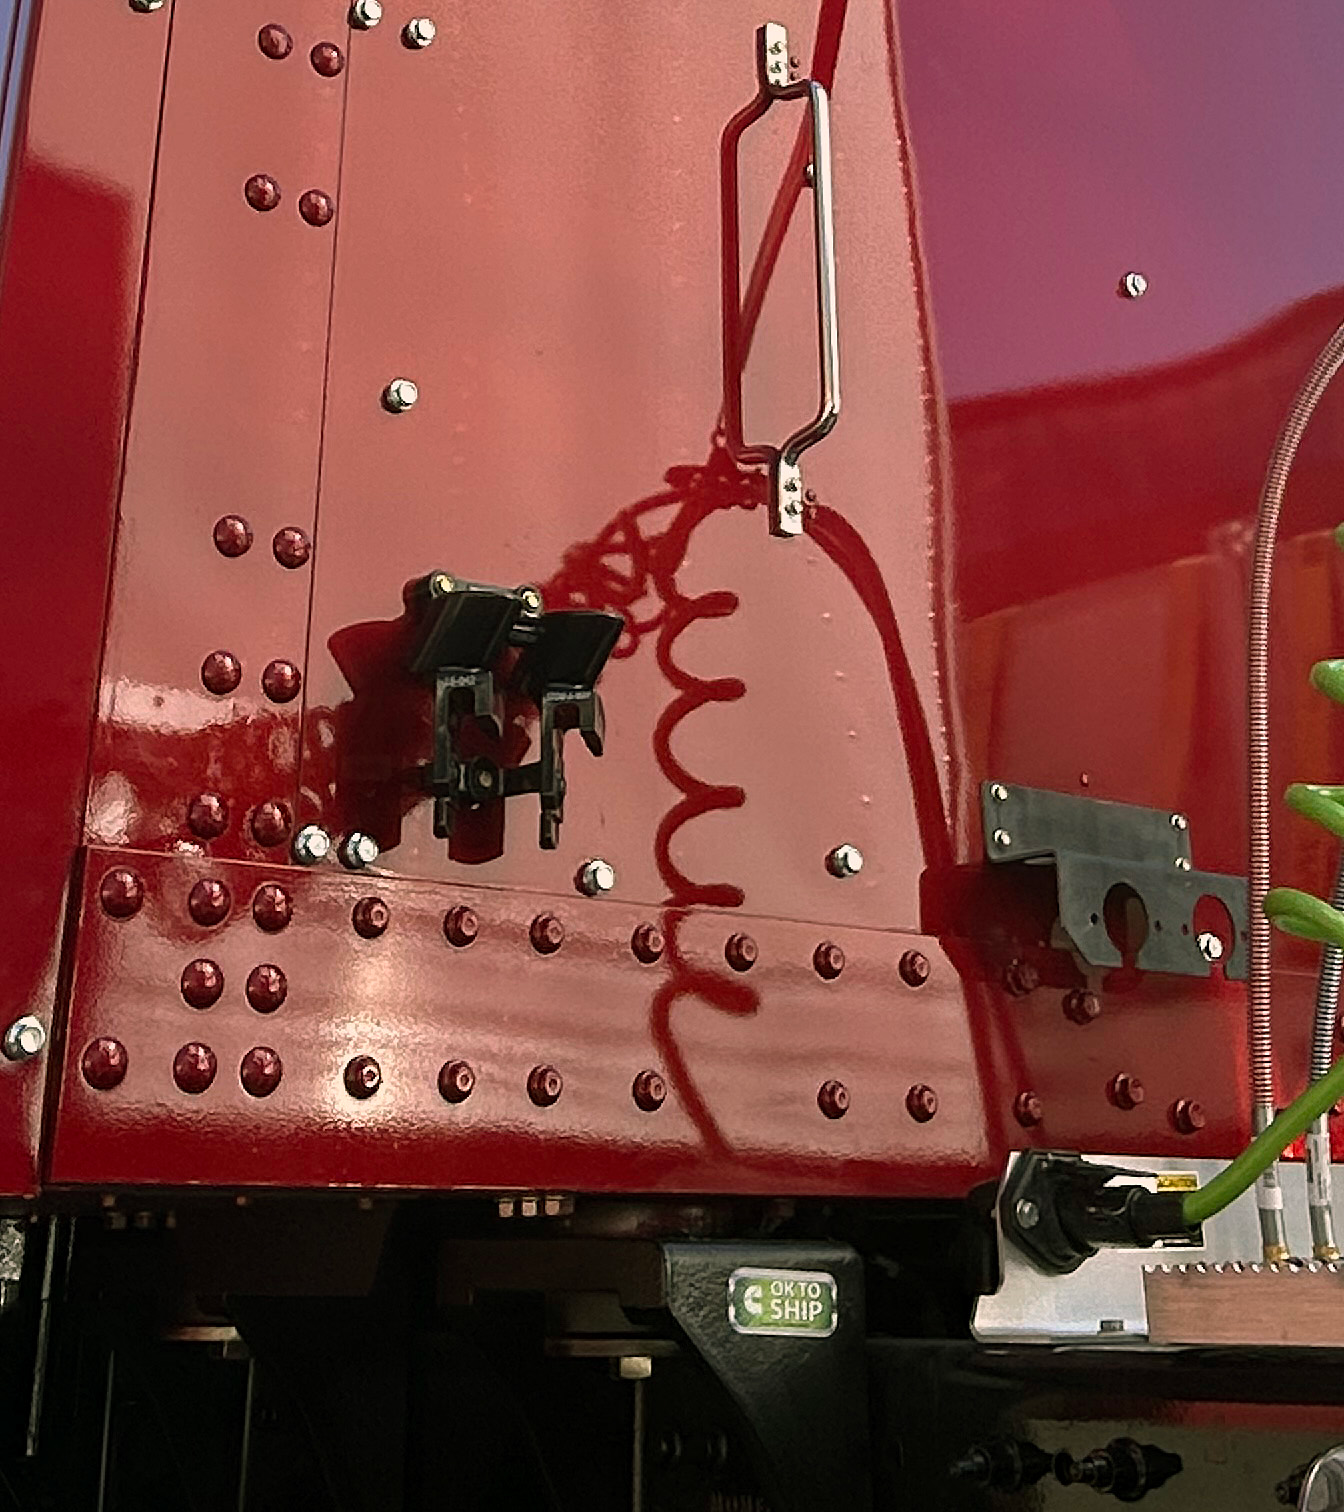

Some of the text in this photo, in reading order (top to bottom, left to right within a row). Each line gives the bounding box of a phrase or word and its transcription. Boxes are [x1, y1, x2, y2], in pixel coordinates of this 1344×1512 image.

[770, 1280, 821, 1298] OK TO
[770, 1299, 823, 1321] SHIP
